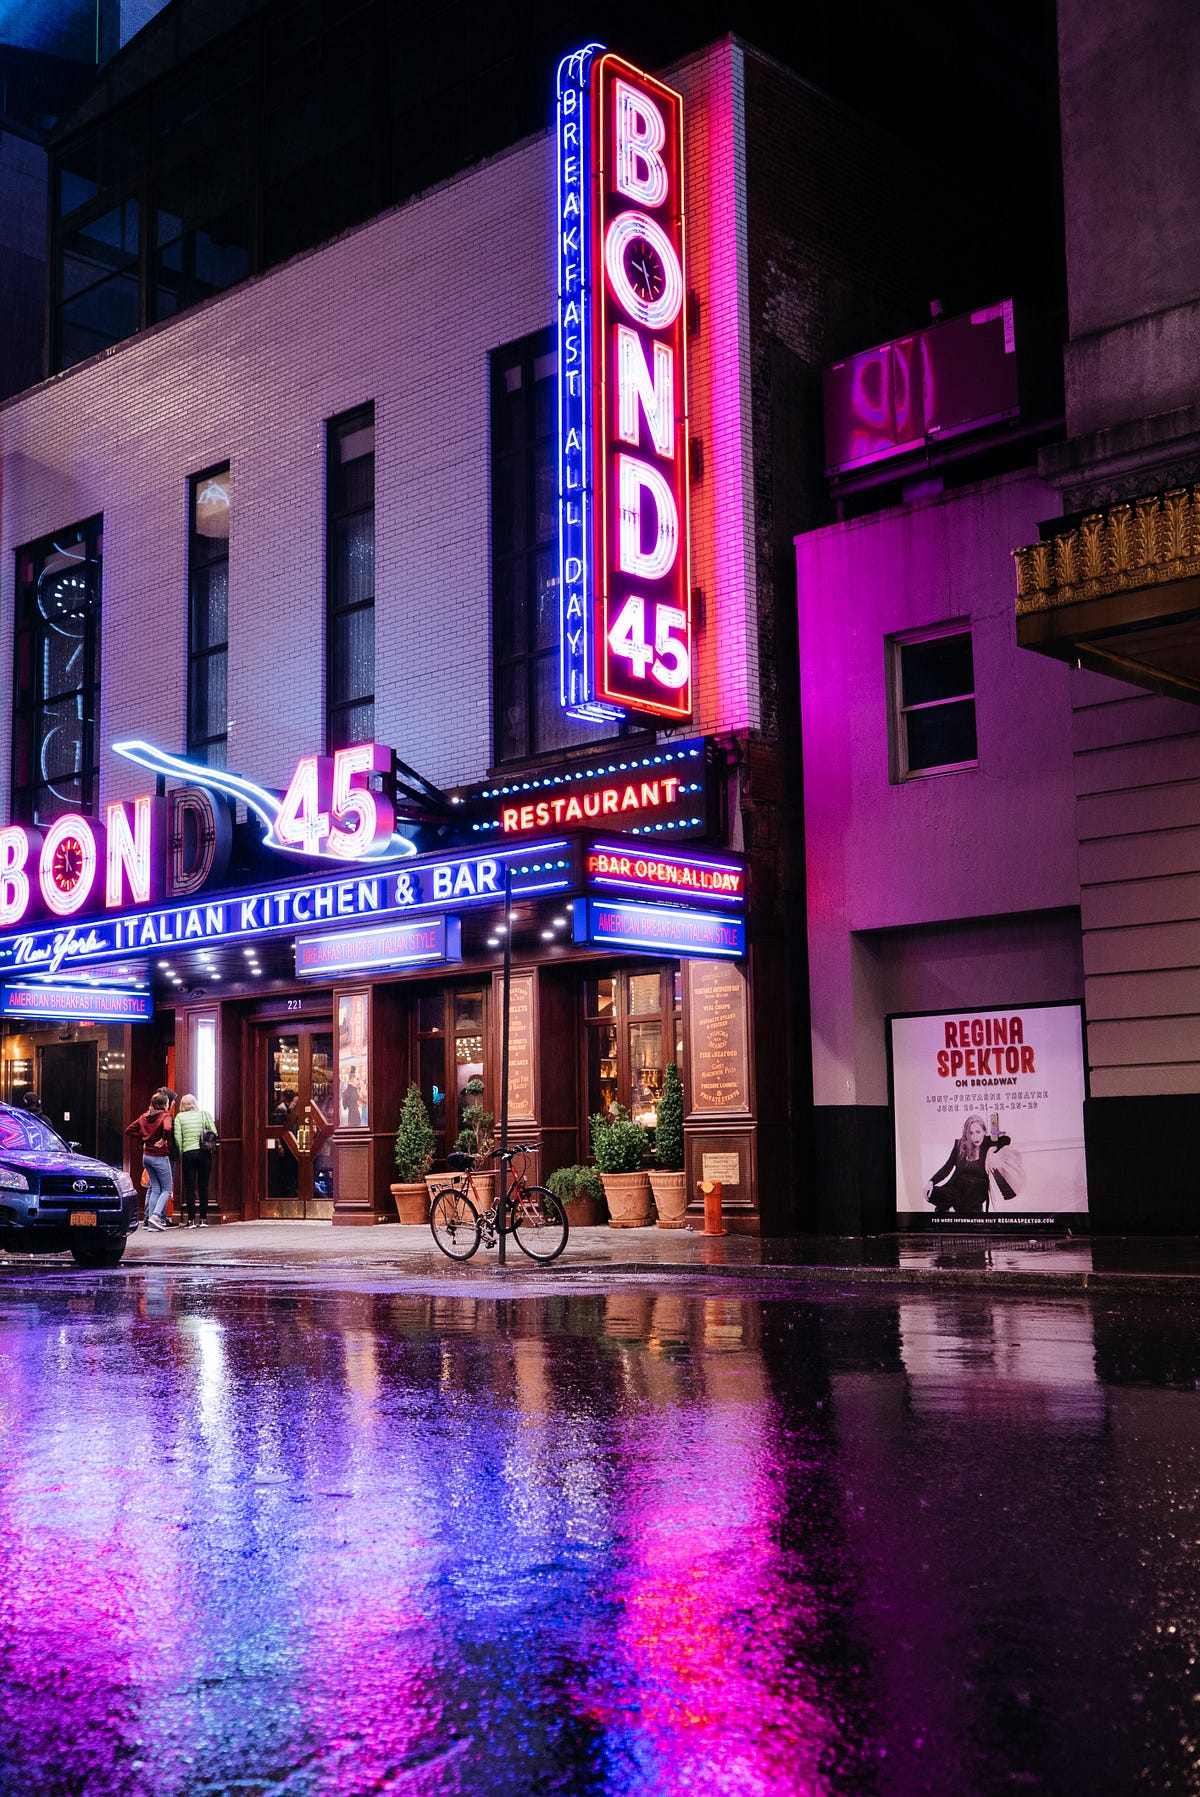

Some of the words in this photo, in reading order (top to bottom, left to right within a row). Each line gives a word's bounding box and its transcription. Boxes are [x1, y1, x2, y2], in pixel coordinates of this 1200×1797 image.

[563, 88, 578, 396] BREAKFAST
[605, 77, 683, 580] BOND
[565, 427, 581, 525] ALL
[565, 557, 582, 654] DAY
[607, 595, 689, 689] 45
[503, 777, 677, 832] RESTAURANT
[0, 786, 217, 925] BOND
[274, 743, 378, 858] 45
[597, 854, 630, 877] BAR
[712, 871, 739, 891] DAY
[13, 936, 52, 964] New
[49, 928, 106, 973] York
[116, 904, 224, 949] ITALIAN
[240, 880, 379, 931] KITCHEN
[394, 873, 415, 905] &
[432, 858, 498, 898] BAR
[598, 912, 640, 936] AMERICAN
[641, 918, 686, 941] BREAKFAST
[688, 923, 715, 943] ITALIAN
[715, 926, 738, 946] STYLE
[303, 944, 346, 965] BREAKFAST
[347, 939, 377, 960] BUFFET
[379, 935, 409, 955] ITALIAN
[410, 930, 436, 951] STYLE
[9, 991, 50, 1007] AMERICAN
[51, 993, 94, 1010] BREAKFAST
[95, 996, 122, 1011] ITALIAN
[123, 998, 145, 1012] STYLE
[287, 999, 302, 1010] 221
[944, 1016, 1024, 1049] REGINA
[936, 1045, 1036, 1078] SPEKTOR
[955, 1079, 968, 1088] ON
[970, 1077, 1018, 1087] BROADWAY
[1004, 1090, 1049, 1101] THEATRE
[936, 1103, 960, 1113] JUNE
